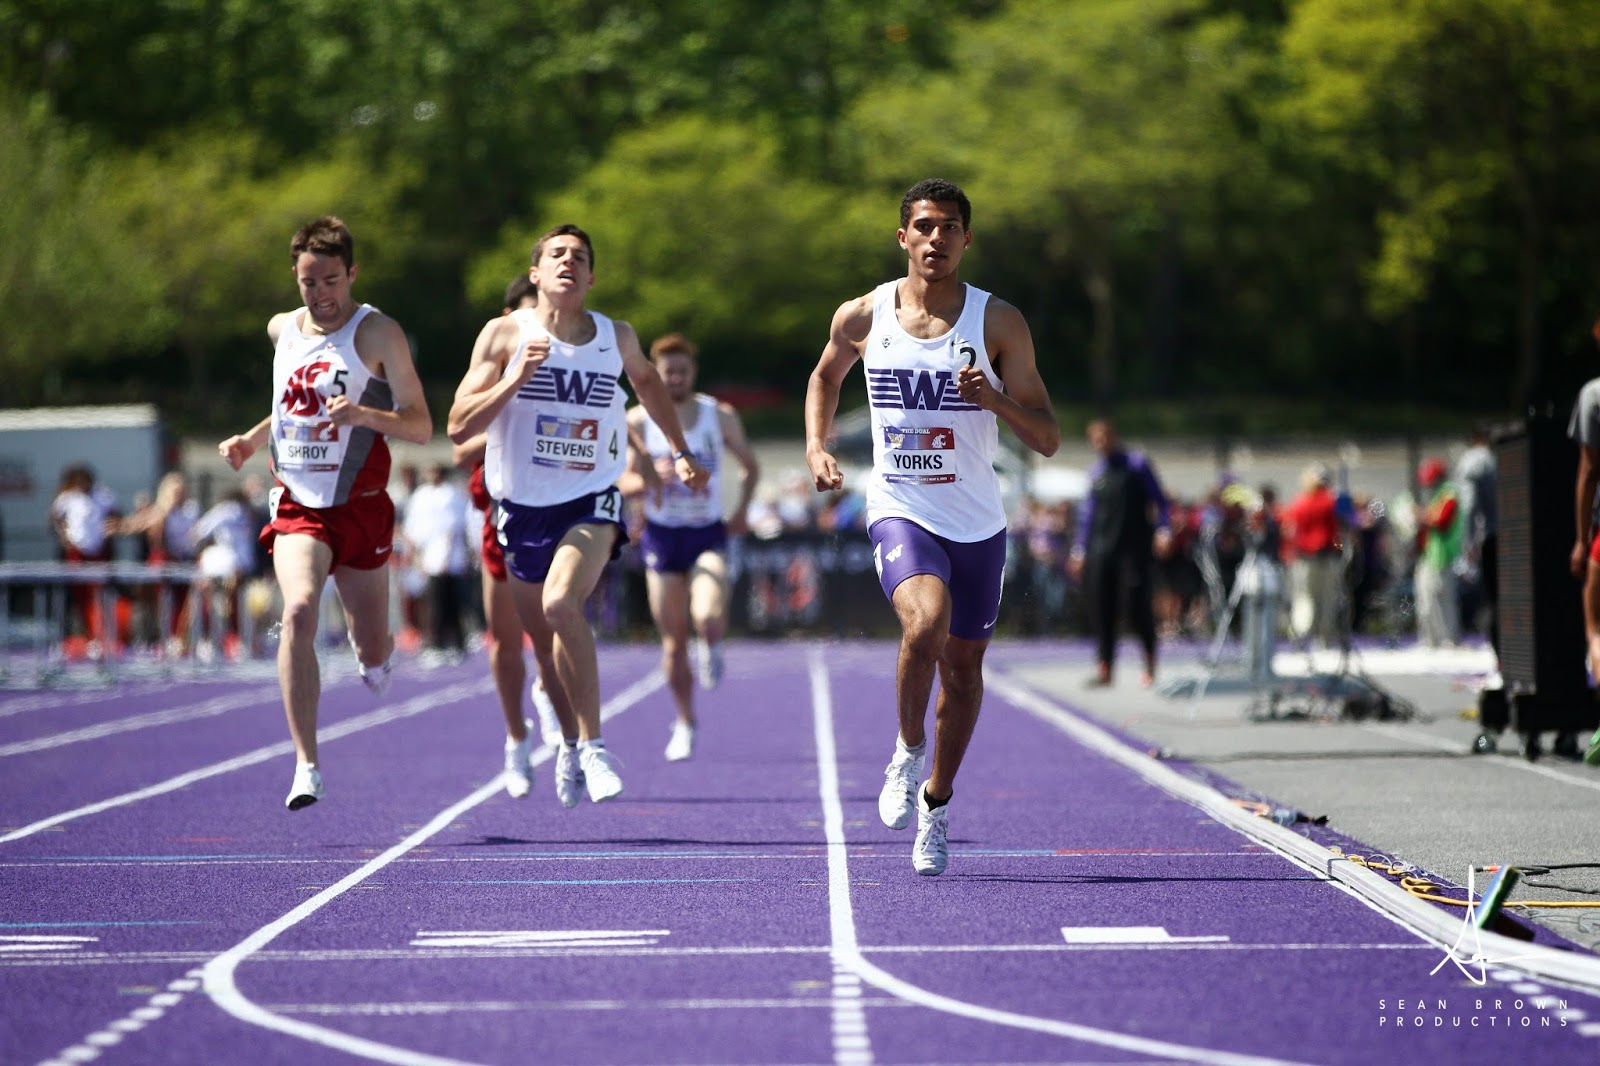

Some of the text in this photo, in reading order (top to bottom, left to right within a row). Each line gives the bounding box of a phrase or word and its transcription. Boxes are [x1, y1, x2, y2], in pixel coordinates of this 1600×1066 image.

[331, 369, 349, 398] 5
[550, 367, 599, 406] W
[892, 368, 953, 411] W
[287, 445, 328, 460] SHROY
[535, 439, 595, 458] STEVENS
[608, 429, 619, 461] 4
[893, 454, 943, 470] YORKS
[601, 489, 615, 518] 4
